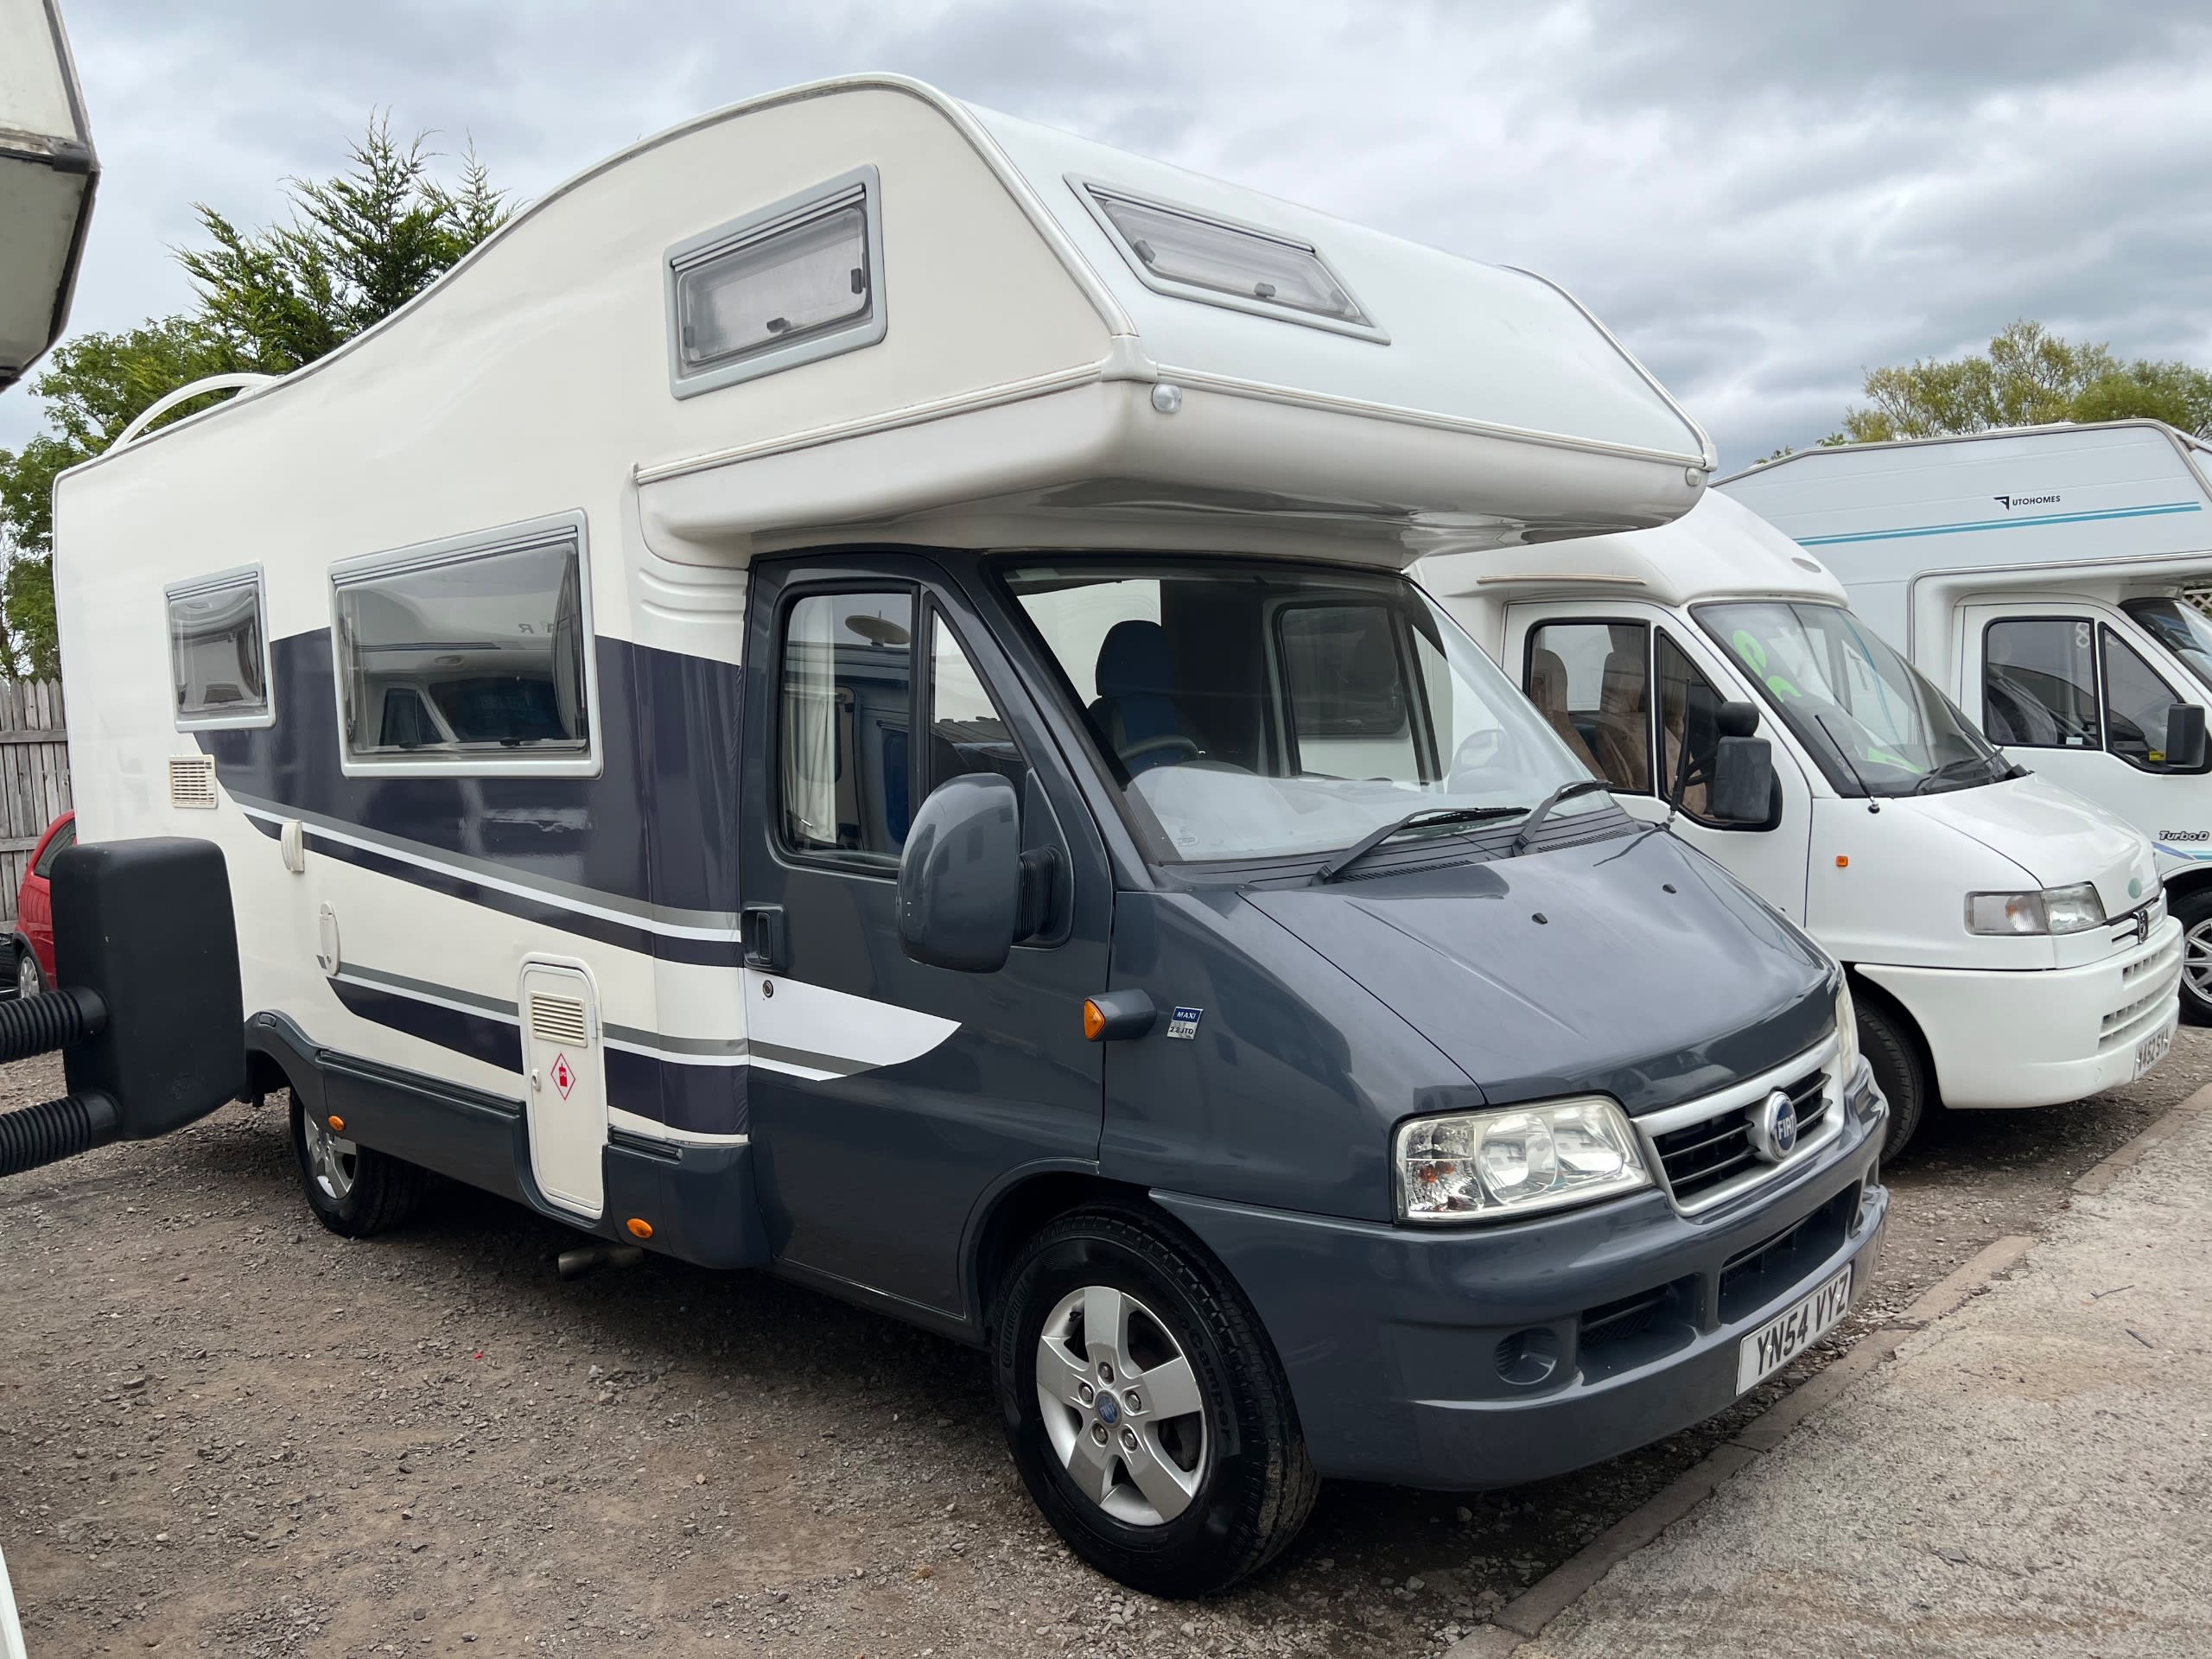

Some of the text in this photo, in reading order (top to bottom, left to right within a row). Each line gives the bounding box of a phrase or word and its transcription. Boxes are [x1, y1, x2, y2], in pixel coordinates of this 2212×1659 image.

[2158, 830, 2197, 842] Turbo
[1176, 1011, 1197, 1020] MAXI
[1777, 1113, 1795, 1141] FIAT
[1757, 1271, 1848, 1376] YN54 VYZ
